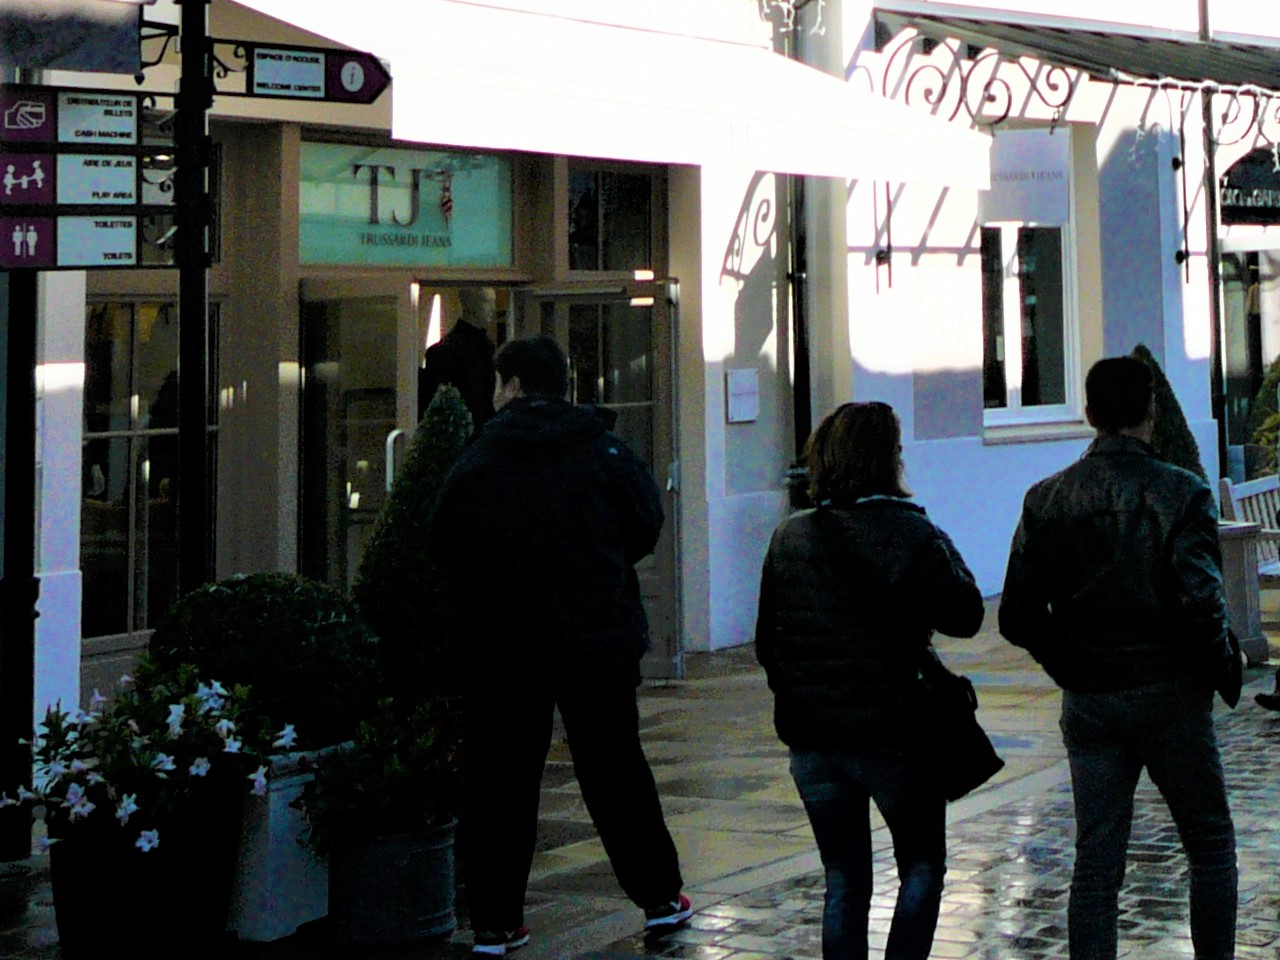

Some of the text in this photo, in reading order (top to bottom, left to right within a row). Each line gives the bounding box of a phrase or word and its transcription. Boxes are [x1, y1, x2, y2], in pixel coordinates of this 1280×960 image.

[256, 82, 292, 91] WELCOME
[75, 130, 96, 138] CASH
[92, 191, 110, 200] PLAY
[353, 164, 421, 227] TJ
[361, 232, 453, 249] TRUSSARDI JEANS
[103, 252, 133, 261] TOILETS
